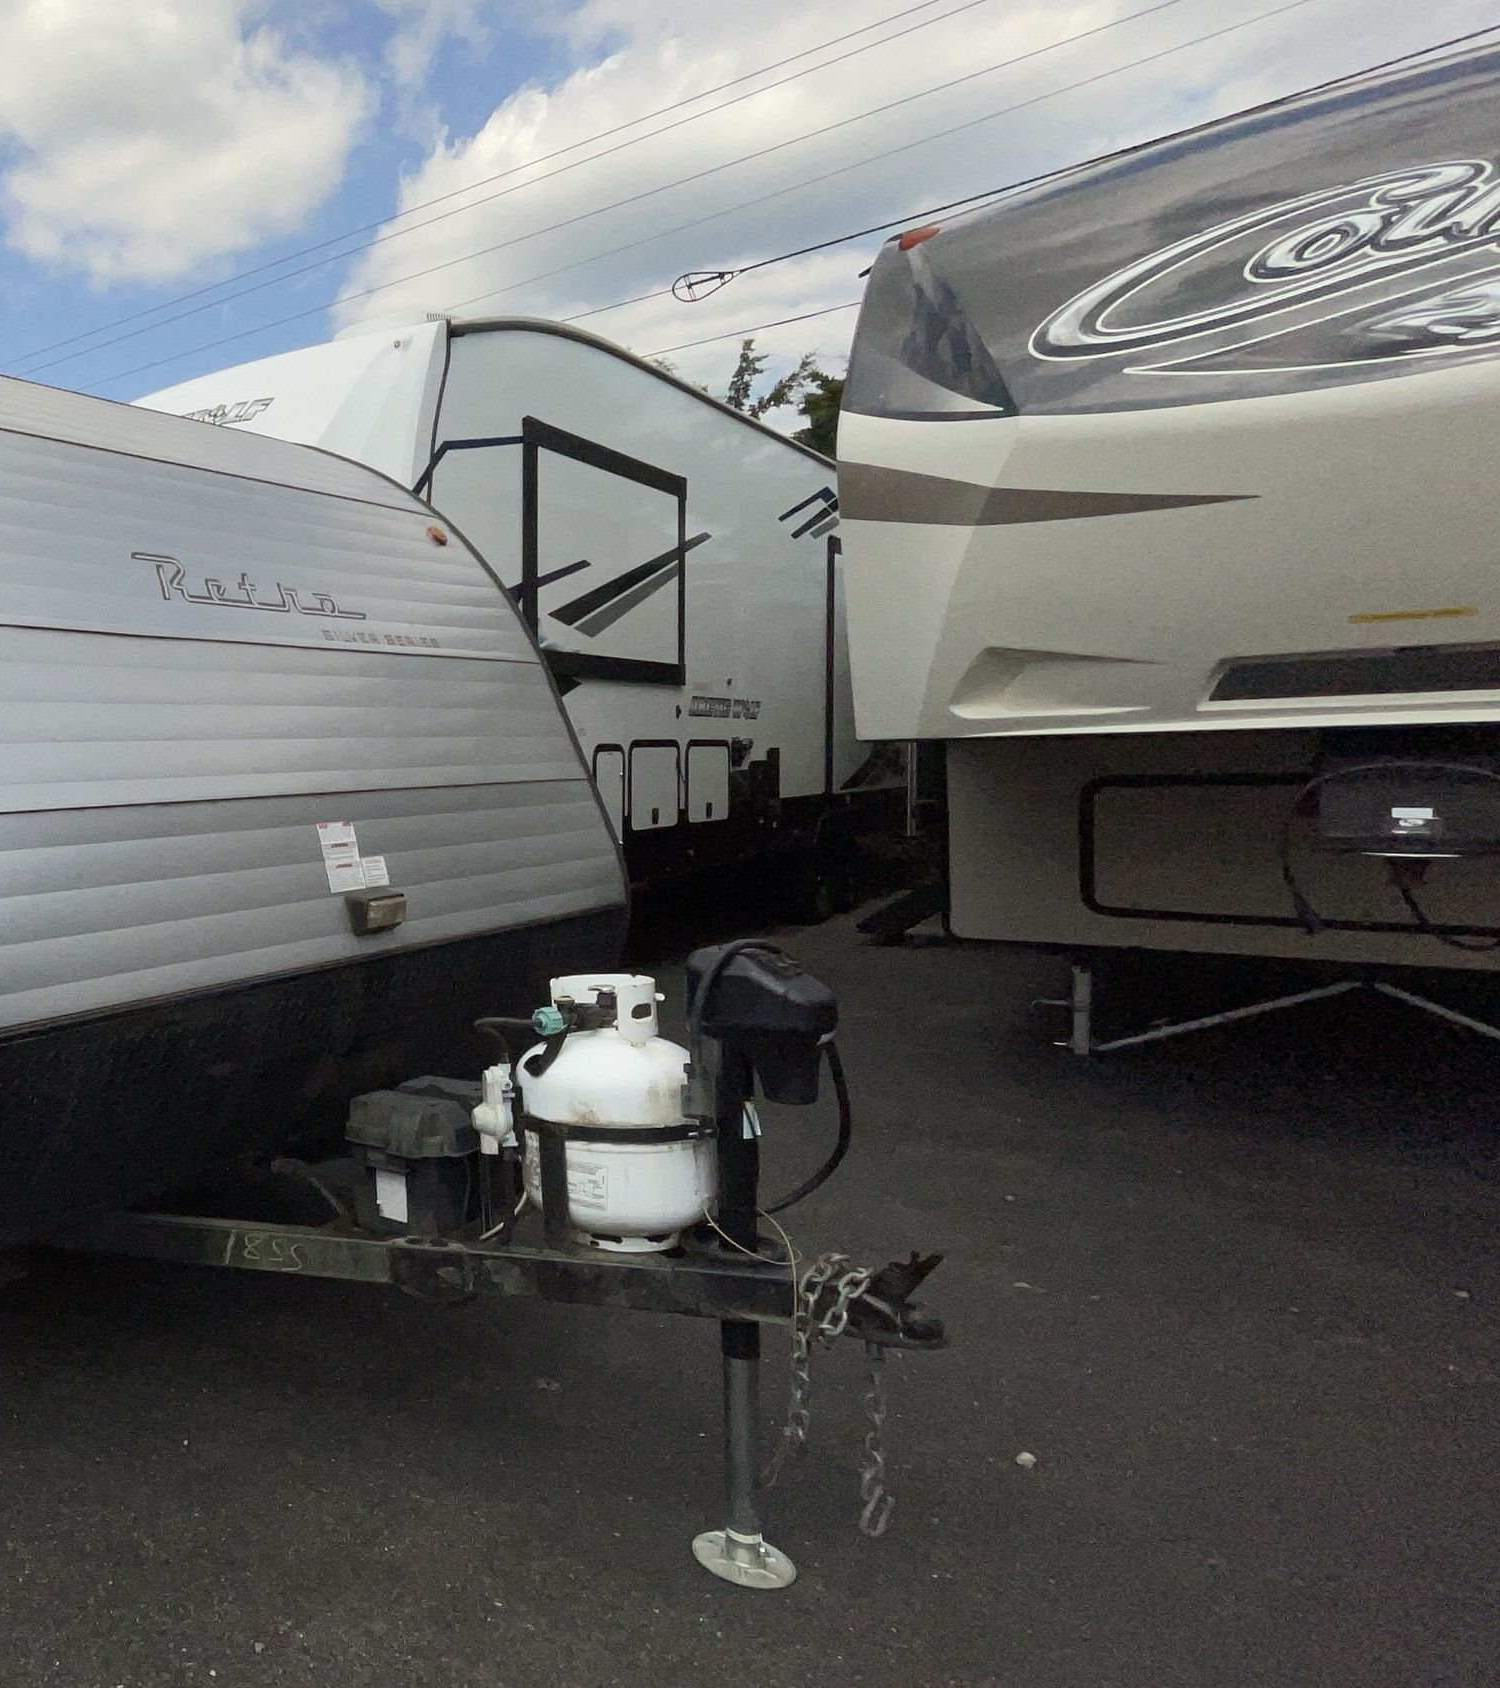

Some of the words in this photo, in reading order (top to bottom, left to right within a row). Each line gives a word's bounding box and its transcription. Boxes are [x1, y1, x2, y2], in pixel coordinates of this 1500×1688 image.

[131, 551, 366, 620] Retro
[321, 629, 380, 645] SILVER
[384, 634, 440, 648] SERIES
